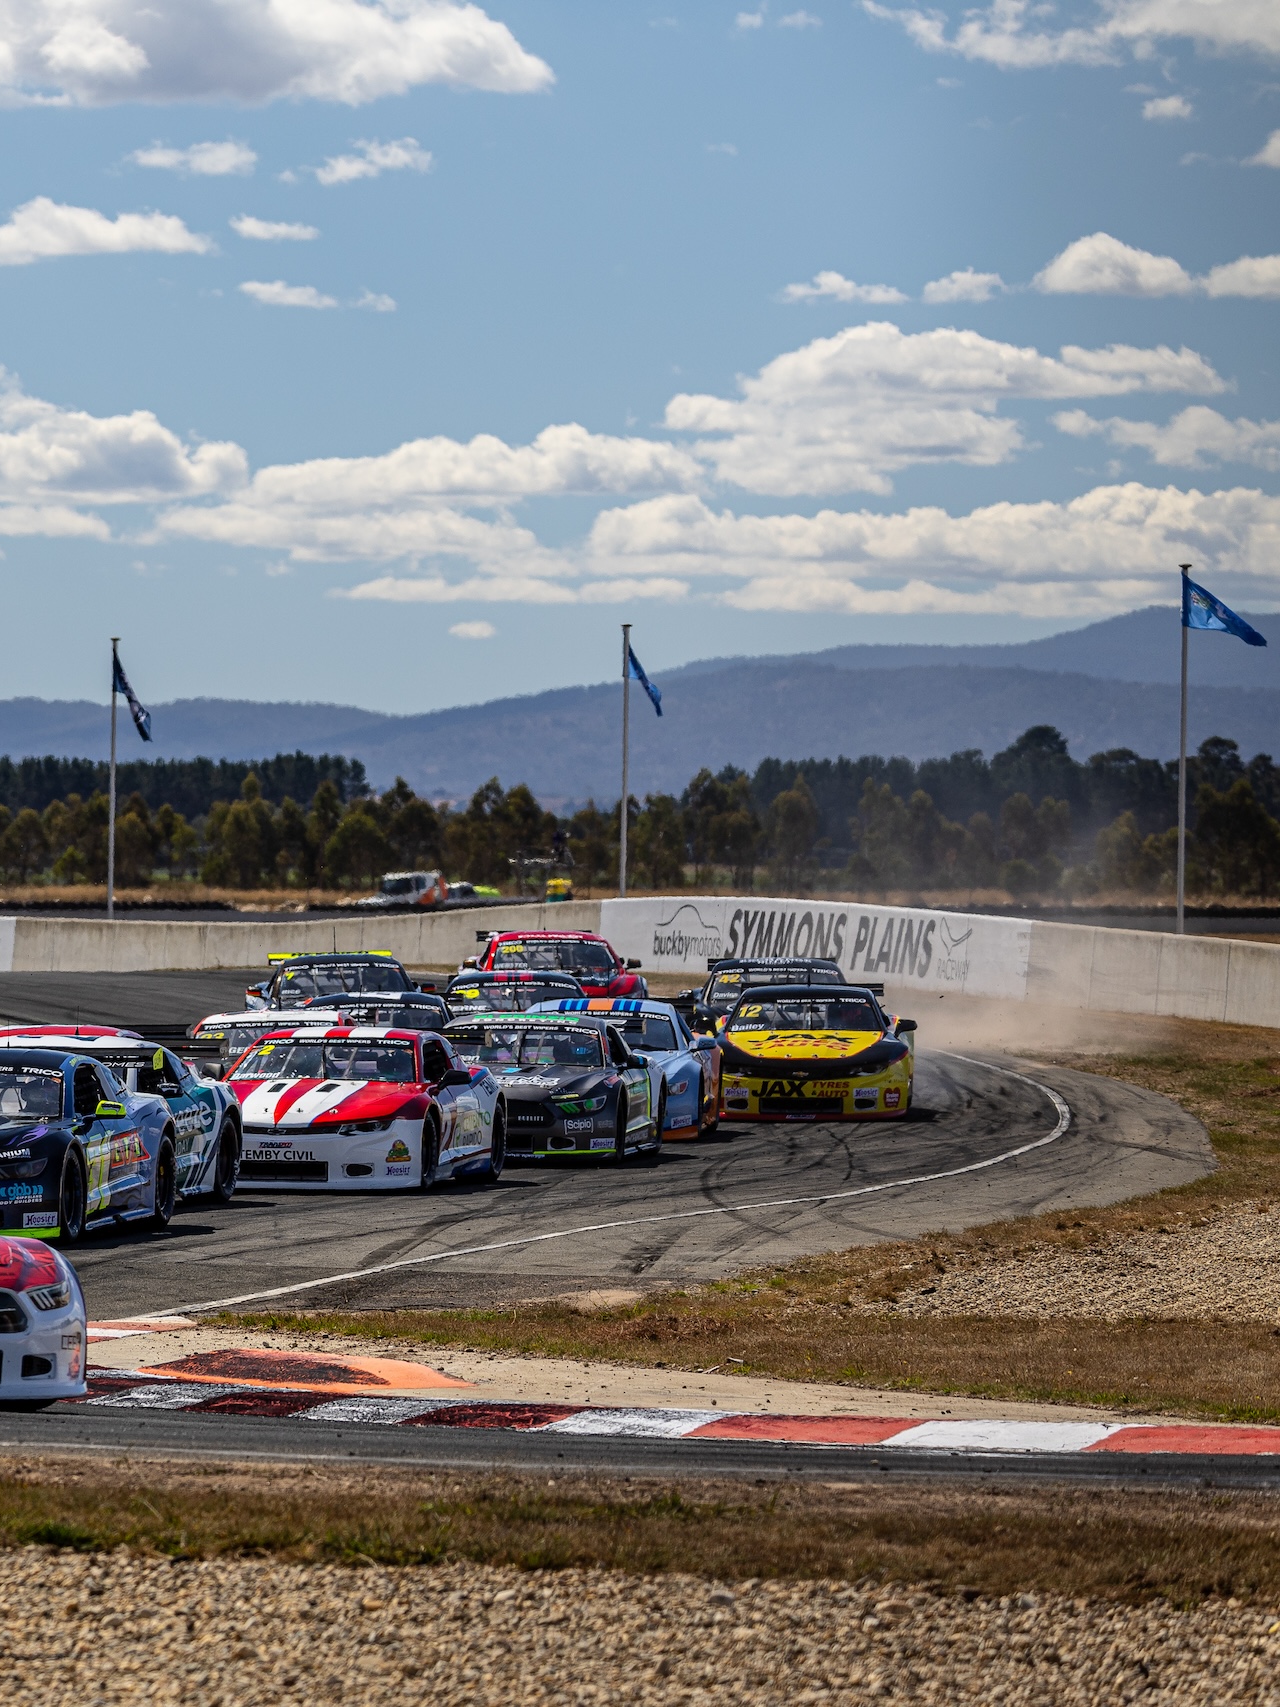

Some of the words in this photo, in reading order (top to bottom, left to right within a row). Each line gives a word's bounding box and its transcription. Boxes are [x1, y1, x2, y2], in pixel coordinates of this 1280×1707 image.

[723, 908, 847, 960] SYMMONS
[850, 915, 936, 978] PLAINS
[501, 945, 524, 953] 200
[936, 957, 971, 980] RACEWAY
[718, 974, 740, 983] 42
[638, 1012, 670, 1020] TRICO
[738, 1005, 762, 1018] 12
[564, 1026, 598, 1034] TRICO
[731, 1023, 765, 1032] Bailey
[263, 1038, 295, 1046] TRICO
[376, 1038, 410, 1046] TRICO
[257, 1044, 276, 1056] 2
[21, 1066, 63, 1077] TRICO
[752, 1080, 805, 1098] JAX
[812, 1081, 850, 1089] TYRES
[818, 1090, 850, 1098] AUTO
[284, 1150, 316, 1160] CIVIL
[386, 1164, 411, 1176] Hoosier
[26, 1214, 56, 1225] Hoosier
